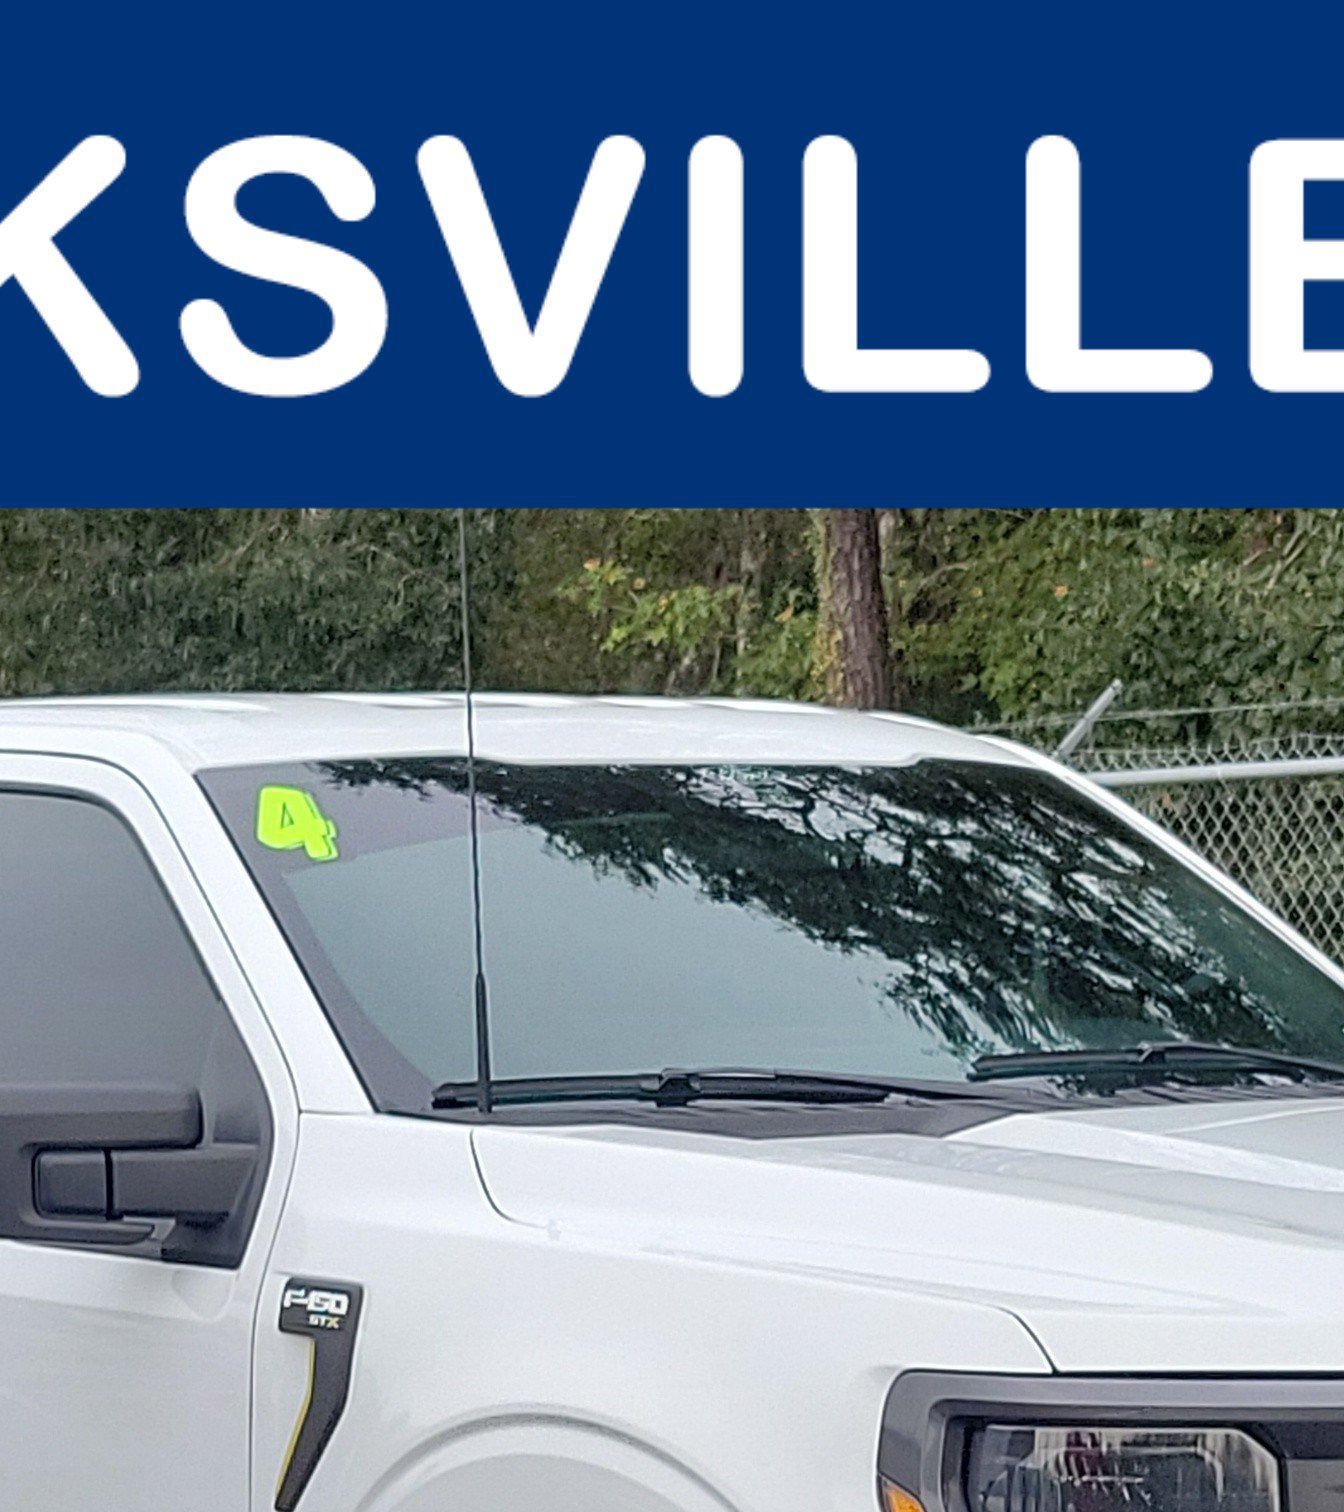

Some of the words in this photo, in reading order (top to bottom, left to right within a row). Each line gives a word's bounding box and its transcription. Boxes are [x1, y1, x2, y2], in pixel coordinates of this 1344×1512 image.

[257, 785, 339, 862] 4
[283, 1289, 350, 1316] F-150
[308, 1314, 341, 1329] STX
